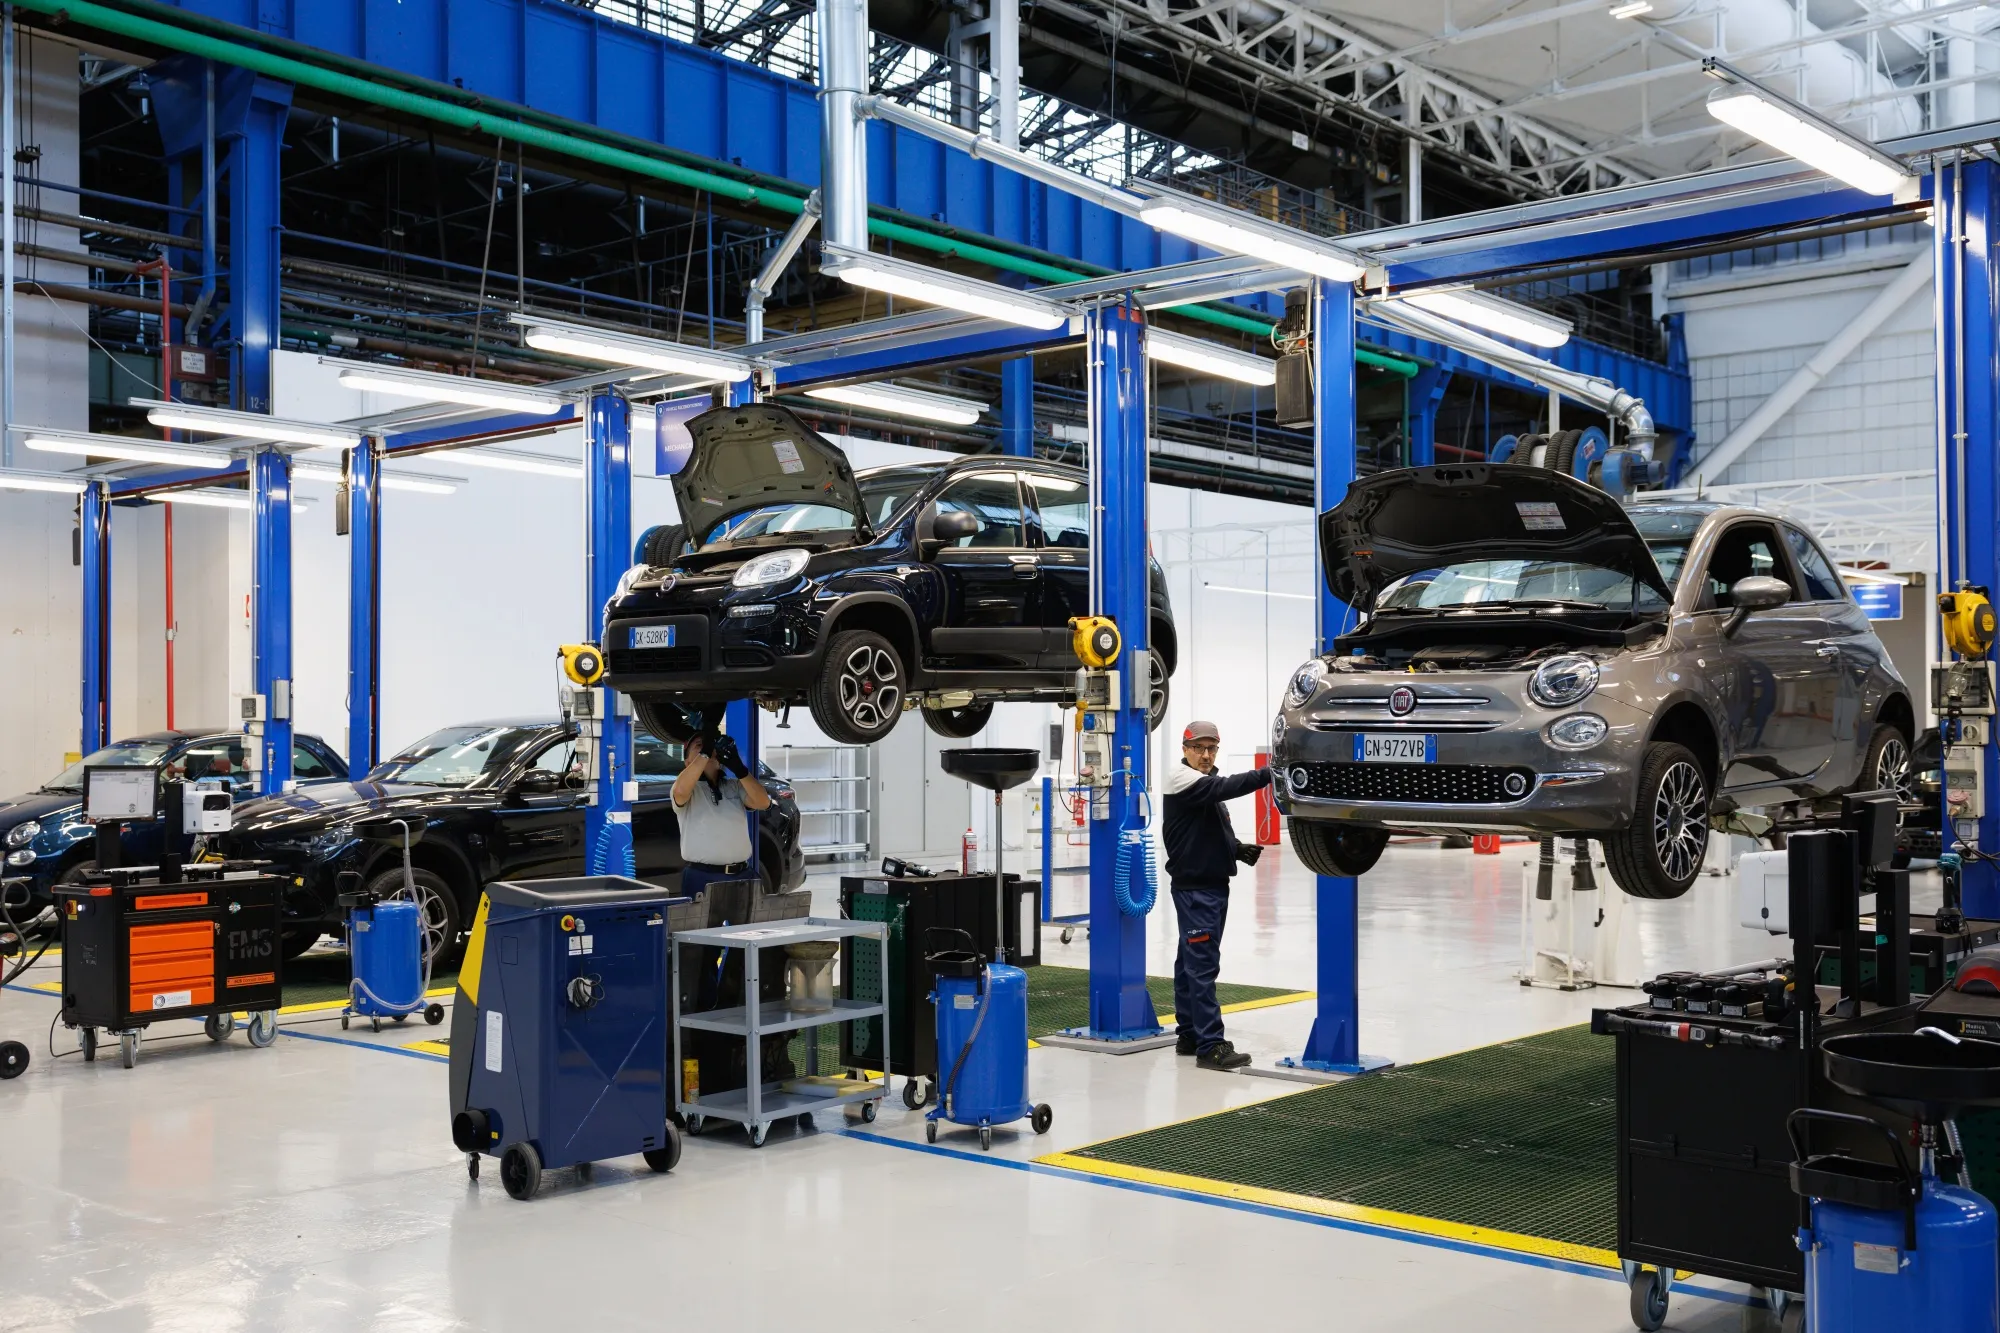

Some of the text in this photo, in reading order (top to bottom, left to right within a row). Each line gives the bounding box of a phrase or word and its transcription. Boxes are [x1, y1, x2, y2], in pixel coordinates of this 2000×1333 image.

[664, 442, 693, 453] MECHANICA
[1395, 695, 1408, 708] FIAT
[229, 928, 273, 960] FMS
